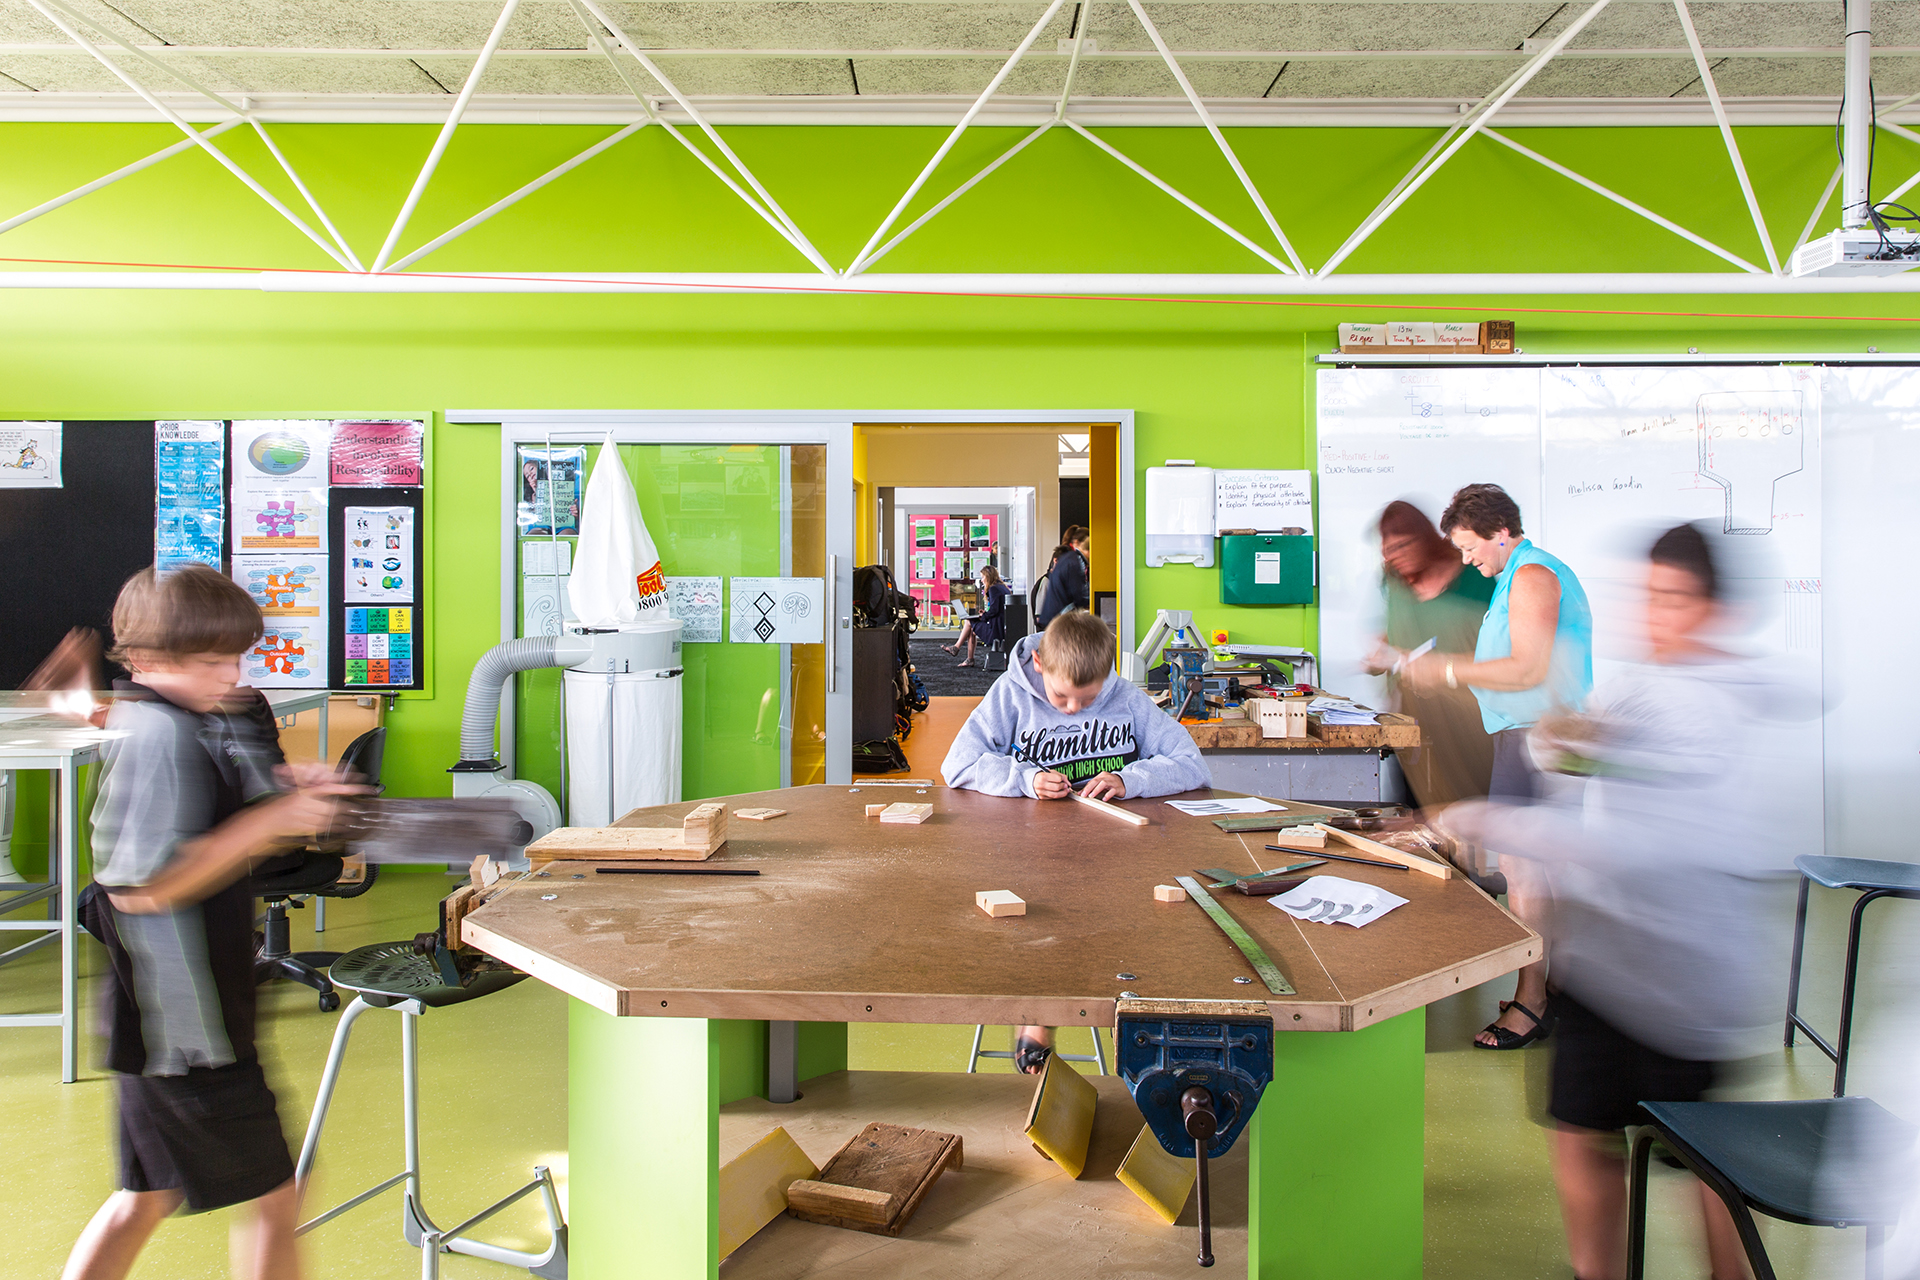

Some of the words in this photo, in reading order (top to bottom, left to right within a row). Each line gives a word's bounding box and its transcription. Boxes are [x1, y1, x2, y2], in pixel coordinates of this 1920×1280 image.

[1662, 414, 1678, 426] hole
[160, 431, 199, 439] KNOWLEDGE
[352, 450, 399, 459] involves
[336, 465, 415, 477] Responsibility
[1568, 481, 1603, 494] Melissa
[1226, 492, 1248, 501] Identify
[1253, 492, 1276, 500] physical
[1226, 501, 1247, 510] Explain
[1015, 718, 1134, 763] Hamilton
[1076, 760, 1094, 778] HIGH
[1097, 756, 1125, 773] SCHOOL
[1171, 1025, 1219, 1035] RECORD
